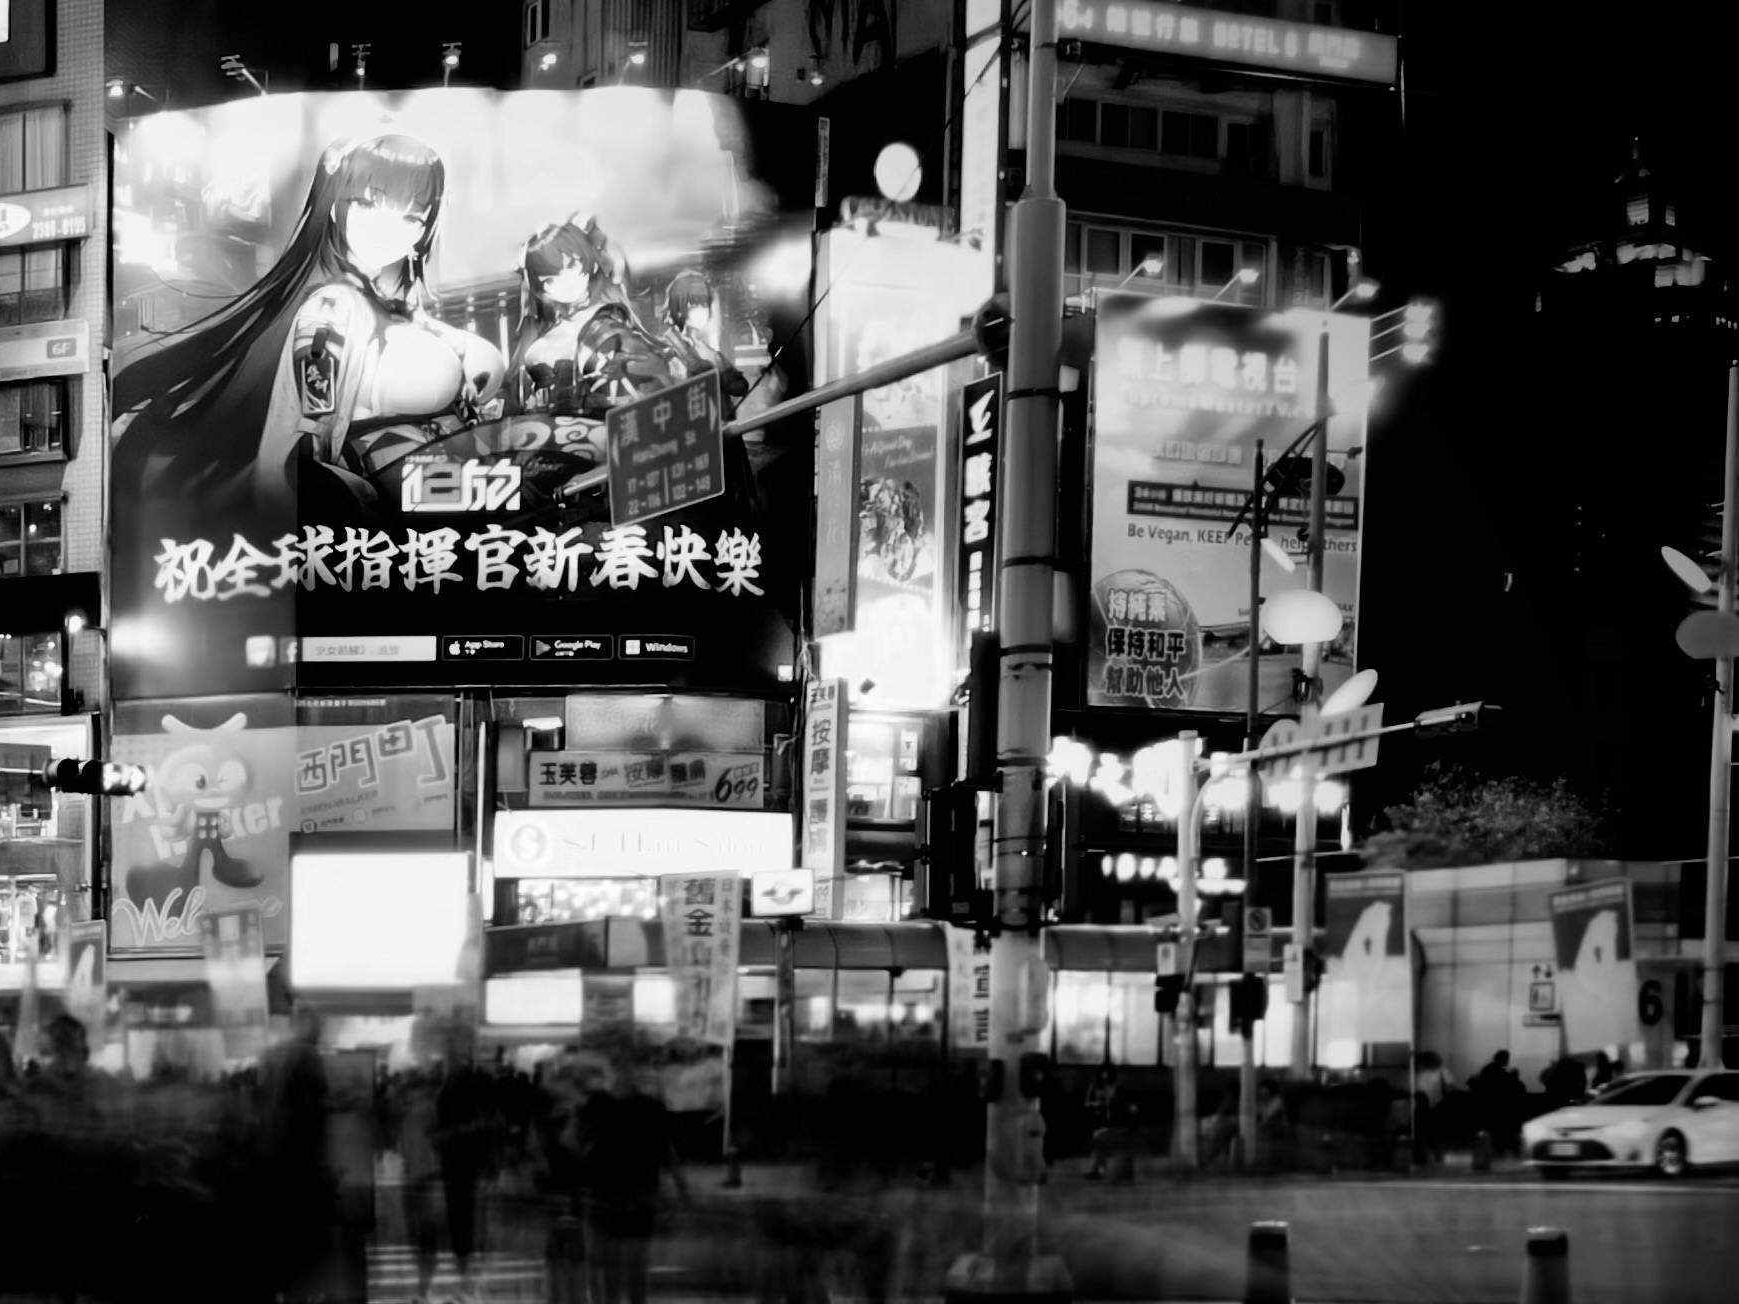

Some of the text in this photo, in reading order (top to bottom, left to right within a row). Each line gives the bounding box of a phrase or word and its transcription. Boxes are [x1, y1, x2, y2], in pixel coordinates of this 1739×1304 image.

[51, 342, 72, 356] 6F
[1127, 523, 1144, 538] Be
[1148, 525, 1192, 544] Vegan,
[154, 525, 765, 603] 祝全球指揮官新春快樂
[554, 640, 583, 651] Google
[645, 642, 689, 653] Windows
[1107, 626, 1185, 664] 保持和平
[1105, 664, 1185, 699] 幫助他人
[295, 715, 450, 795] 西門町
[714, 766, 760, 804] 699
[1638, 980, 1662, 1026] 6
